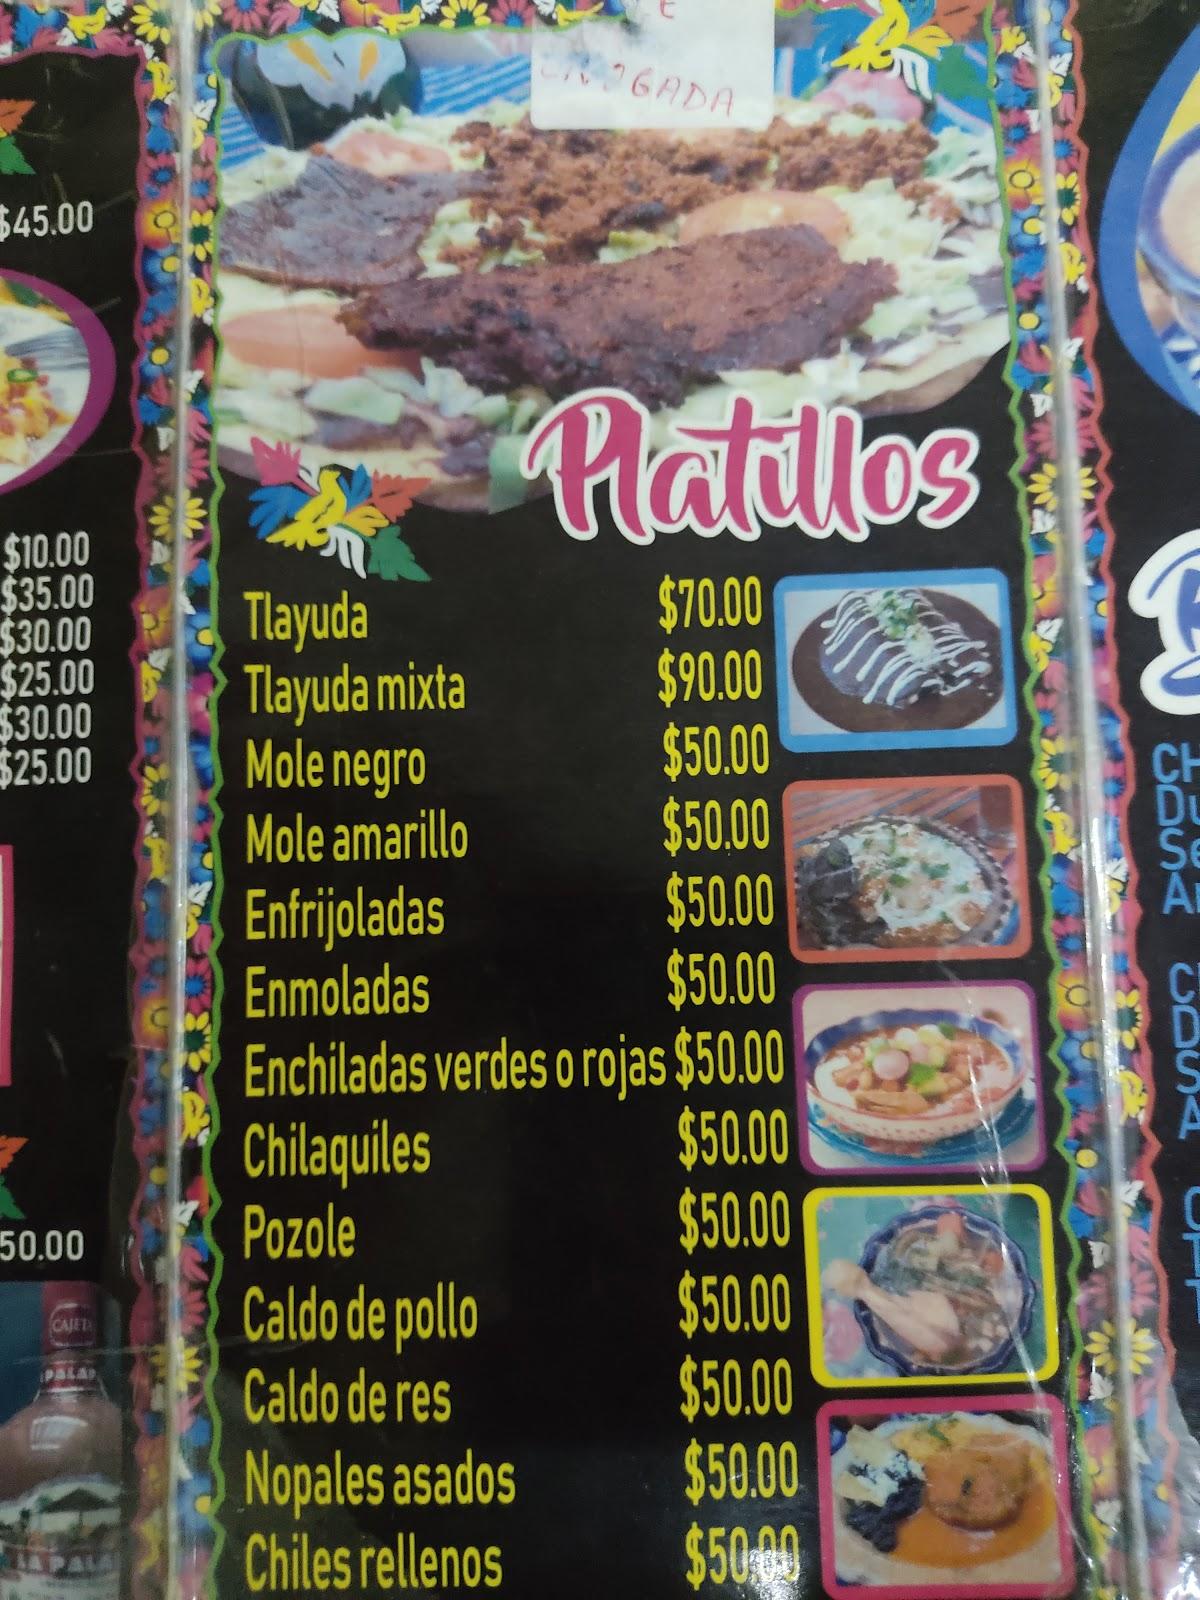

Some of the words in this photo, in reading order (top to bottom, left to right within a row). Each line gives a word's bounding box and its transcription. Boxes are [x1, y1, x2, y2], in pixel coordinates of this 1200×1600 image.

[0, 200, 93, 242] $45.00
[524, 389, 976, 541] Platillos
[4, 531, 90, 573] $10.00
[1, 574, 95, 616] $35.00
[243, 590, 368, 653] Tlayuda
[658, 574, 762, 634] $70.00
[0, 616, 92, 658] $30.00
[0, 659, 95, 701] $25.00
[243, 662, 369, 726] Tlayuda
[377, 662, 466, 711] mixta
[657, 648, 763, 708] $90.00
[0, 702, 92, 745] $30.00
[0, 747, 92, 789] $25.00
[247, 738, 324, 788] Mole
[333, 746, 426, 799] negro
[663, 722, 769, 782] $50.00
[247, 812, 324, 863] Mole
[332, 808, 468, 861] amarillo
[662, 796, 770, 857] $50.00
[246, 885, 445, 951] Enfrijoladas
[666, 871, 774, 933] $50.00
[246, 962, 430, 1018] Enmoladas
[667, 948, 776, 1012] $50.00
[245, 1040, 427, 1097] Enchiladas
[435, 1036, 547, 1090] verdes
[556, 1049, 574, 1088] o
[583, 1034, 667, 1101] rojas
[674, 1026, 784, 1091] $50.00
[244, 1119, 431, 1189] Chilaquiles
[678, 1105, 789, 1172] $50.00
[244, 1202, 356, 1259] Pozole
[679, 1187, 791, 1255] $50.00
[244, 1285, 338, 1342] Caldo
[347, 1284, 386, 1340] de
[396, 1281, 478, 1354] pollo
[679, 1270, 791, 1339] $50.00
[244, 1367, 339, 1424] Caldo
[347, 1367, 387, 1423] de
[396, 1379, 451, 1423] res
[680, 1354, 793, 1423] $50.00
[245, 1449, 385, 1520] Nopales
[393, 1448, 516, 1505] asados
[685, 1437, 799, 1506] $50.00
[245, 1532, 352, 1592] Chiles
[360, 1532, 503, 1589] rellenos
[685, 1521, 799, 1591] $50.00
